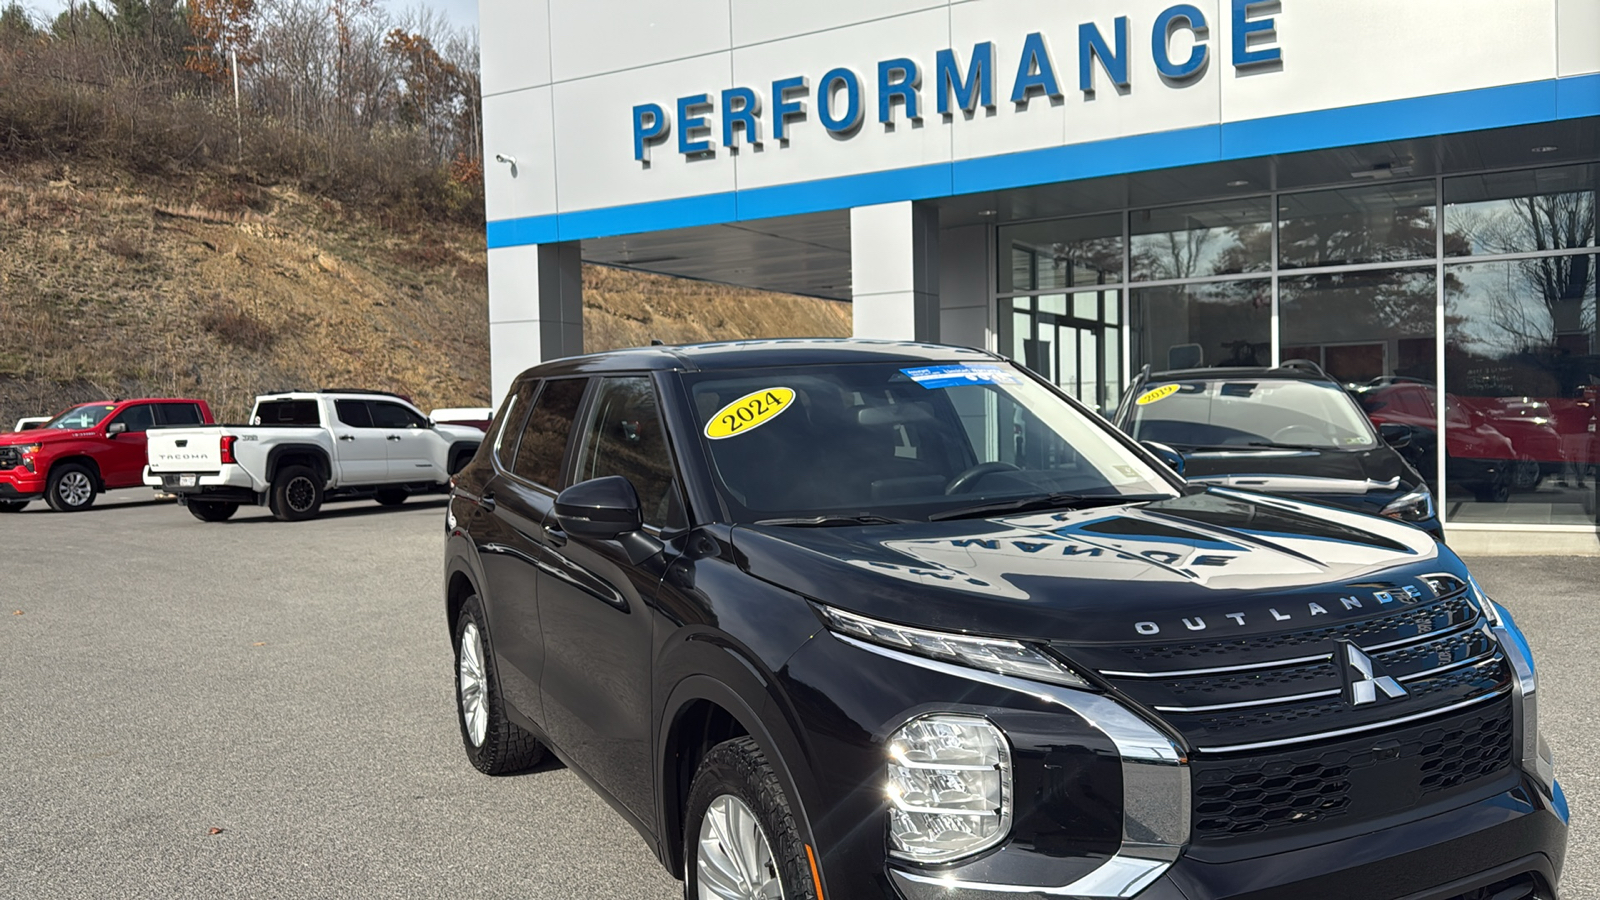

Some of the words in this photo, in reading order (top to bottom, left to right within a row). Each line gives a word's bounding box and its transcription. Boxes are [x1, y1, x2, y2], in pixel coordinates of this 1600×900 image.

[632, 0, 1283, 169] PERFORMANCE
[722, 391, 783, 432] 2024
[1134, 579, 1446, 635] OUTLANDER
